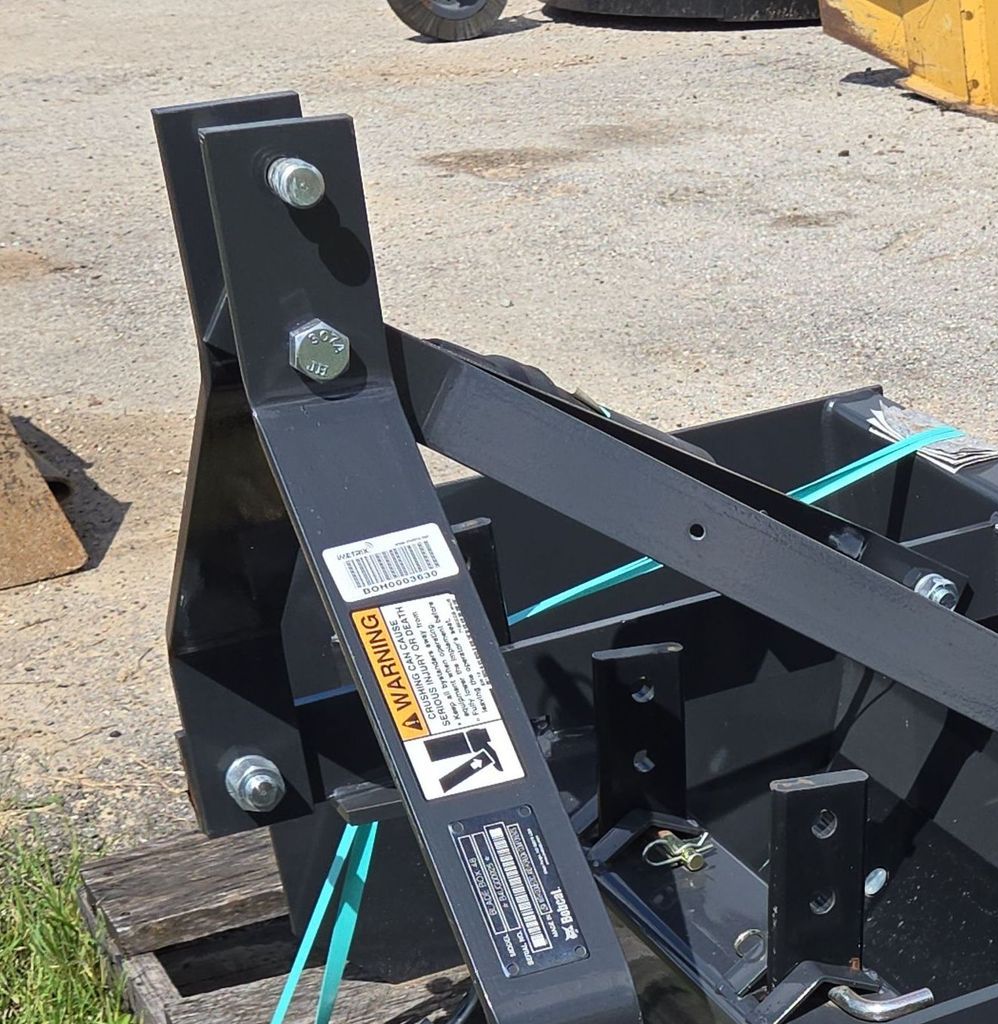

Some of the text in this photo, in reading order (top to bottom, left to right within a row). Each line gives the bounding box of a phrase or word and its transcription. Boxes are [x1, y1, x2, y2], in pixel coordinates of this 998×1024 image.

[428, 601, 441, 624] before
[427, 624, 445, 657] operating
[361, 614, 412, 711] WARNING
[395, 606, 451, 727] SERIOUS INJURY OR DEATH
[412, 611, 461, 720] Keep all bystanders away from
[453, 637, 471, 672] operator's
[389, 619, 437, 720] CRUSHING CAN CAUSE
[442, 659, 454, 679] when
[454, 663, 463, 675] the
[468, 674, 477, 686] the
[450, 680, 470, 717] equipment
[459, 677, 471, 697] lower
[473, 687, 488, 713] leaving
[468, 698, 479, 716] Fully
[474, 870, 487, 888] BOX
[481, 889, 498, 916] BLADE
[550, 886, 573, 924] Bobcat
